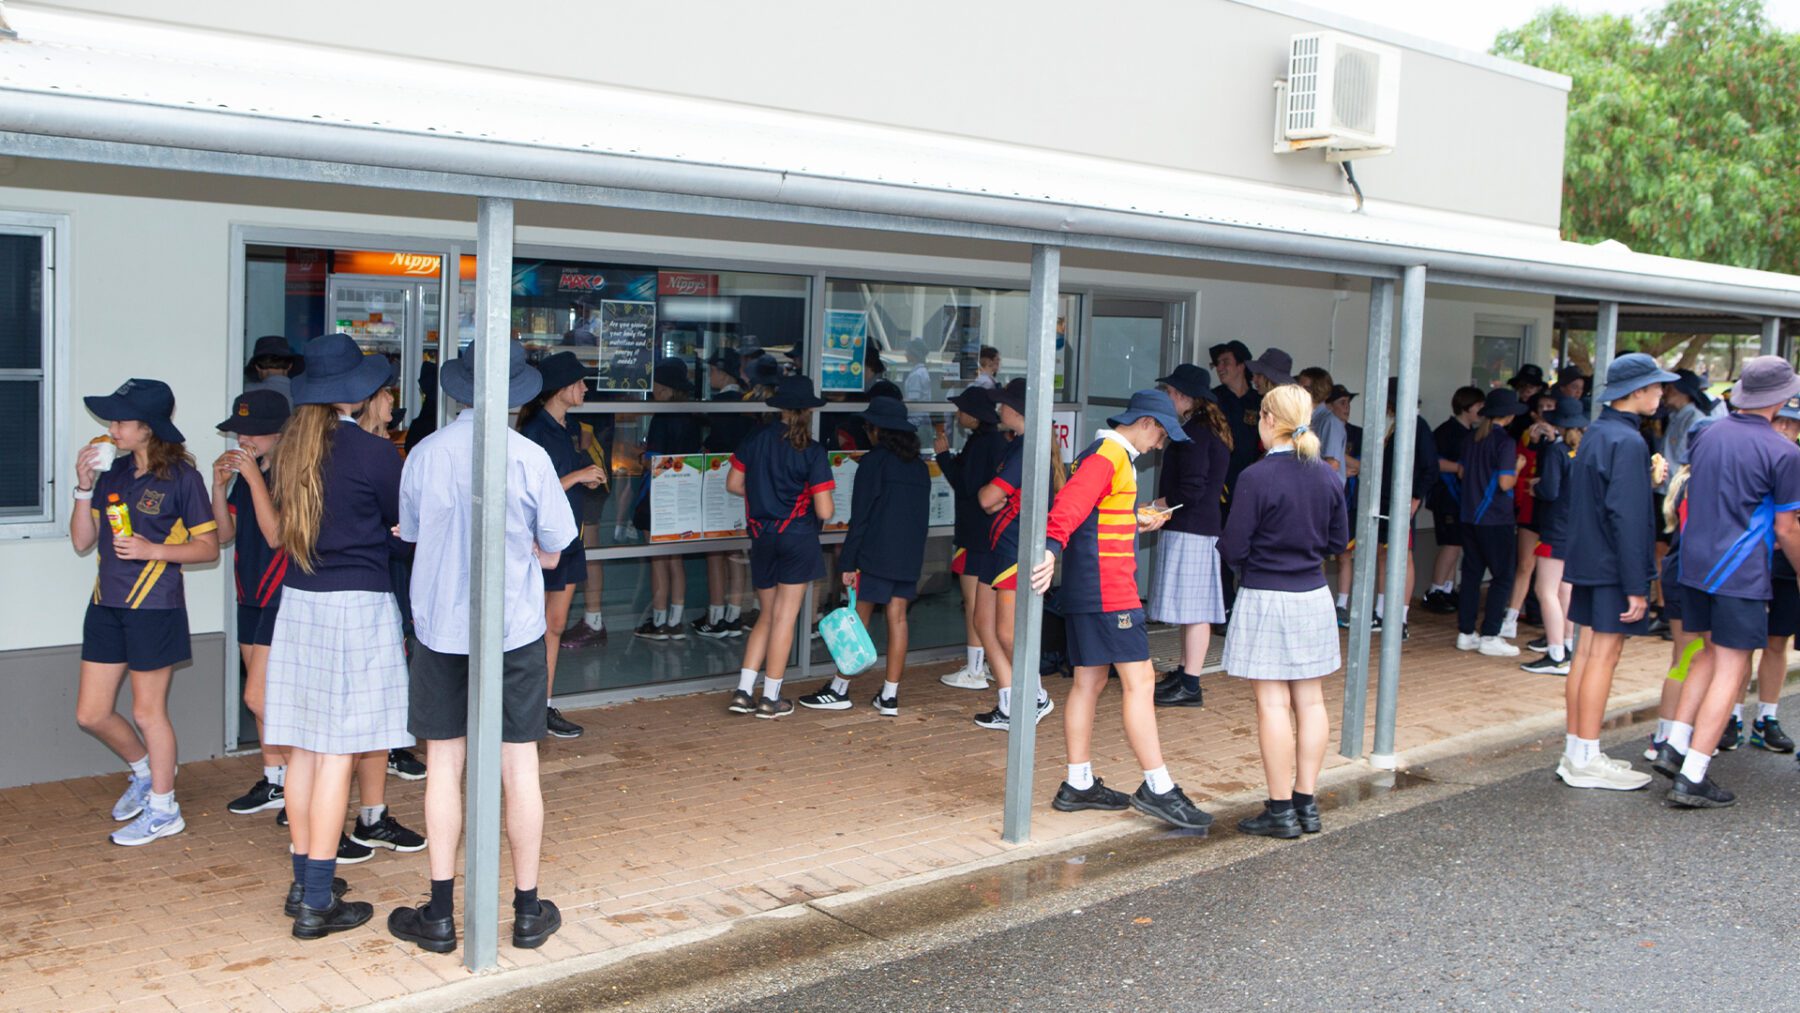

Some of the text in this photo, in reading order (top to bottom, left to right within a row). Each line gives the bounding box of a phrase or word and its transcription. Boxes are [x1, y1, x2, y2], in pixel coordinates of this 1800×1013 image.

[390, 253, 440, 274] Nippy
[558, 273, 593, 289] MAX
[623, 330, 637, 339] body
